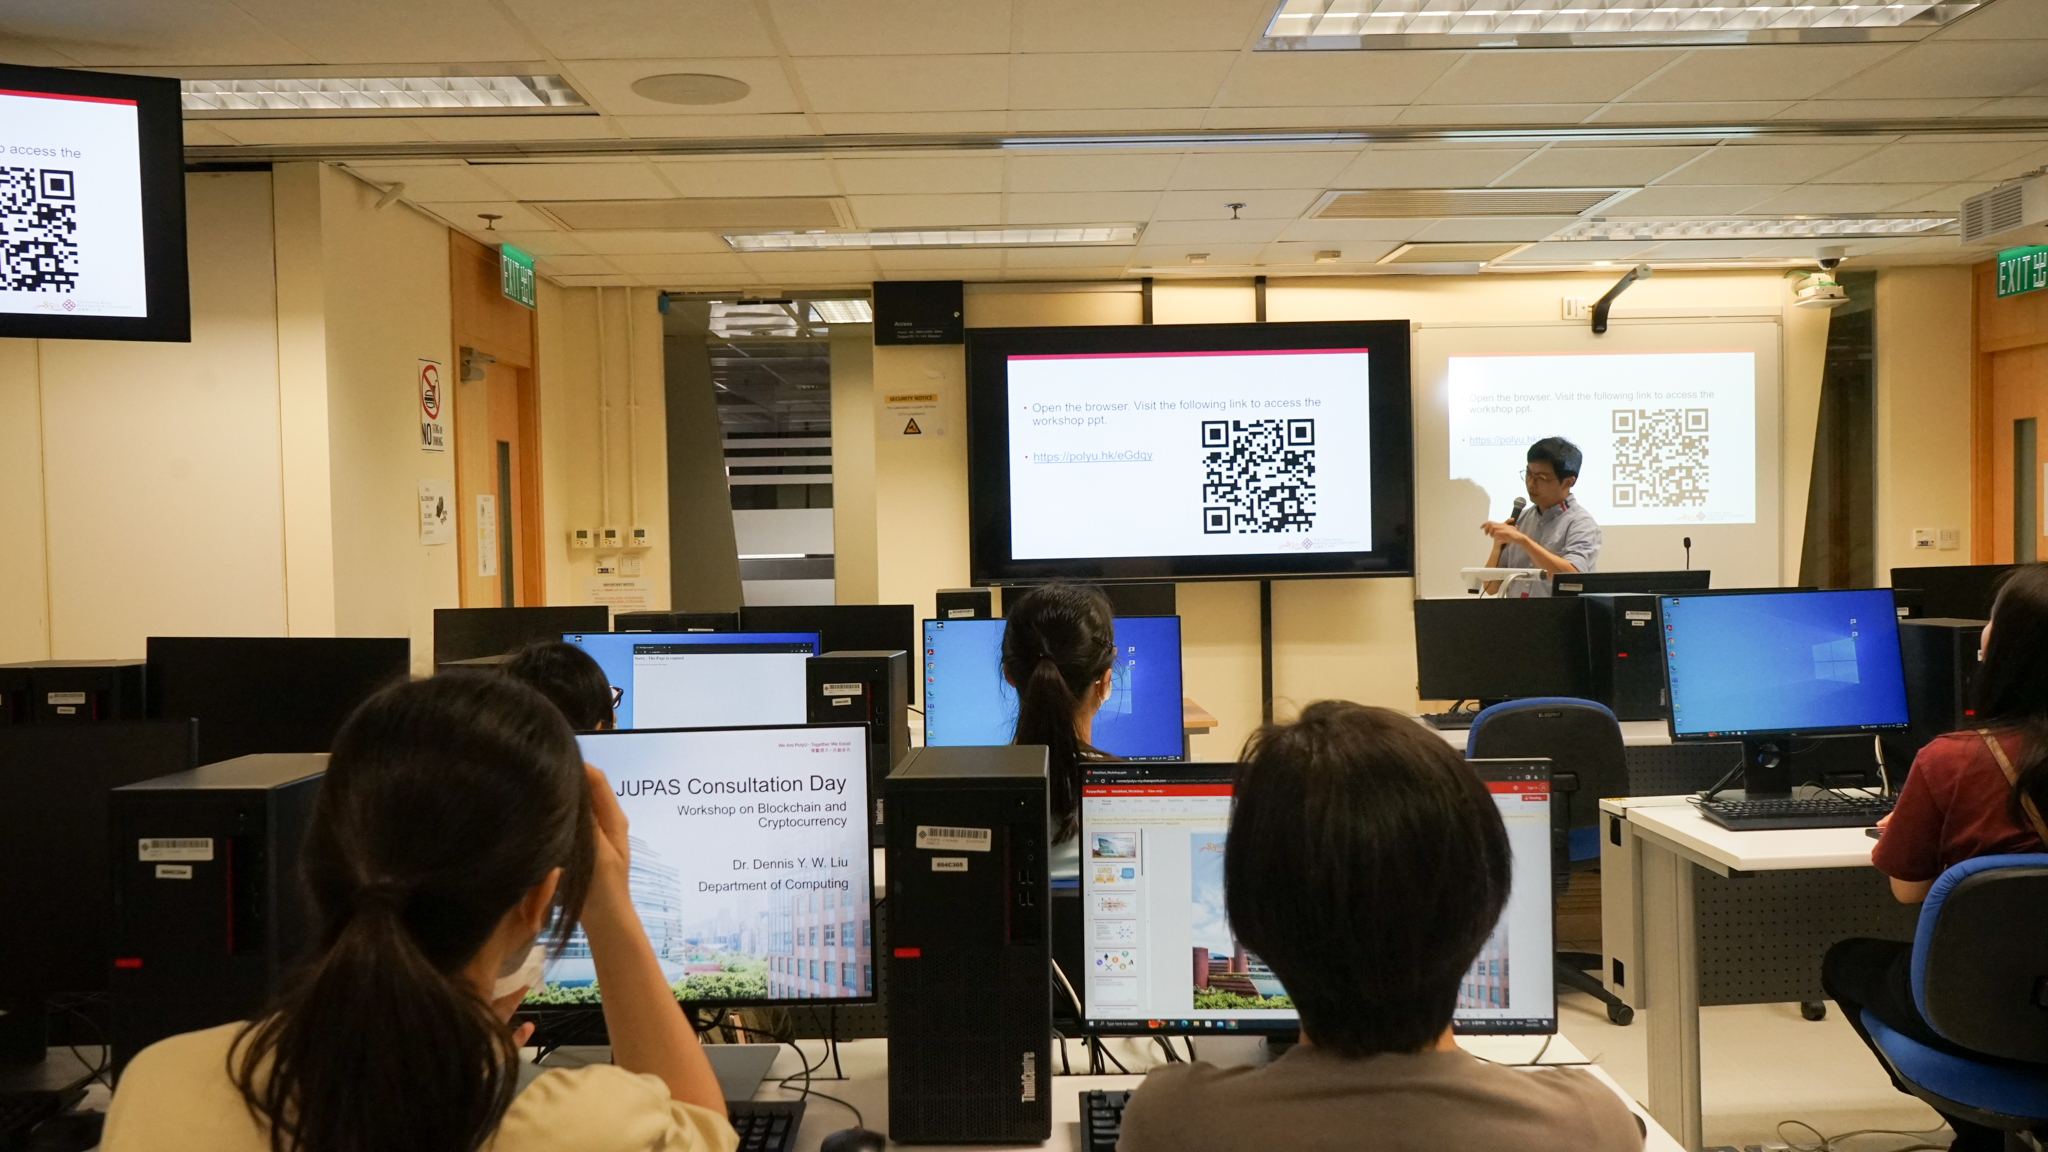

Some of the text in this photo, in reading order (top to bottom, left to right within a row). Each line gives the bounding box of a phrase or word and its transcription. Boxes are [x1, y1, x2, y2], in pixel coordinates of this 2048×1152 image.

[10, 146, 56, 157] access
[61, 148, 81, 158] the
[503, 254, 520, 299] EXIT
[2000, 255, 2031, 295] EXIT
[1469, 394, 1494, 403] Open
[1514, 394, 1552, 402] browser.
[1577, 392, 1591, 400] the
[1594, 391, 1634, 402] following
[1636, 391, 1652, 400] link
[1700, 390, 1714, 398] the
[1032, 398, 1322, 414] Open the browser. Visit the following link to access the
[1469, 405, 1532, 414] workshop ppt.
[1032, 416, 1107, 426] workshop ppt.
[422, 423, 432, 446] NO
[1033, 450, 1153, 462] https://polyu.hk/eGdqy
[616, 774, 846, 796] JUPAS Consultation Day
[678, 801, 846, 816] Workshop on Blockchain and
[758, 816, 847, 830] Cryptocurrency
[733, 857, 848, 870] Dr. Dennis Y. W. Liu
[698, 878, 849, 894] Department of Computing
